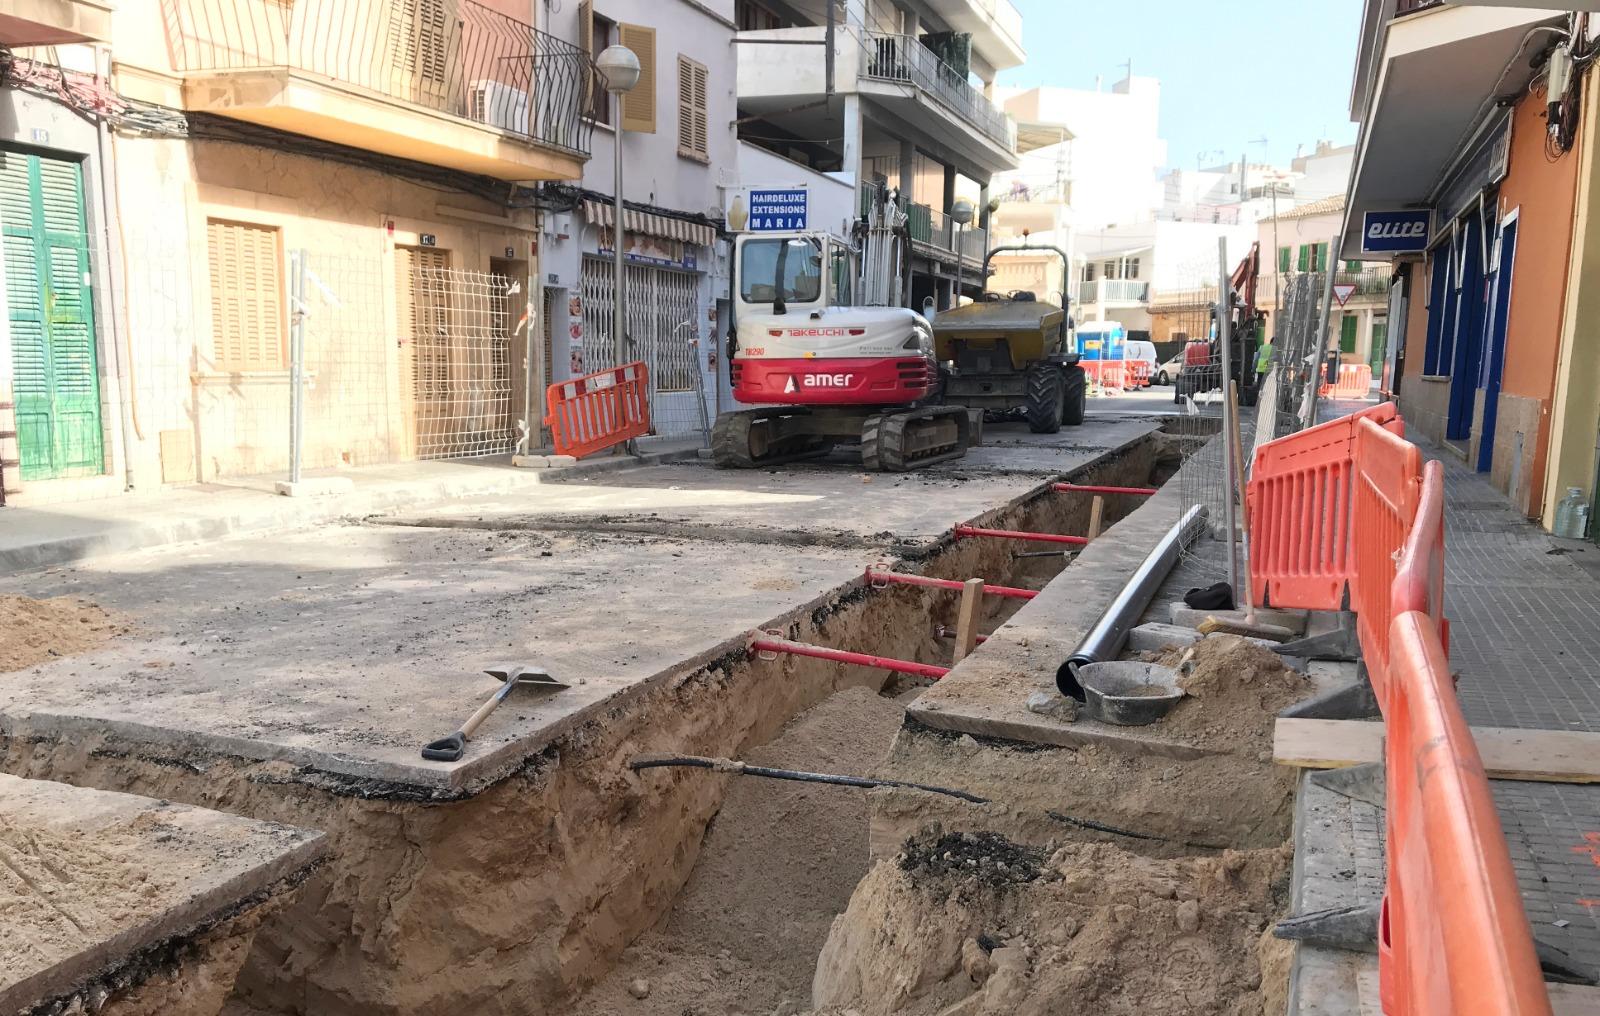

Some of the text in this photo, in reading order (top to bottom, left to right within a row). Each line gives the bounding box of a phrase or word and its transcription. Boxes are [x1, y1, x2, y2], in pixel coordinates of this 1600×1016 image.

[752, 194, 805, 203] HAIRDELUXE
[752, 205, 805, 214] EXTENSIONS
[752, 218, 804, 228] MARIA
[1368, 221, 1426, 239] elite
[803, 374, 854, 387] amer
